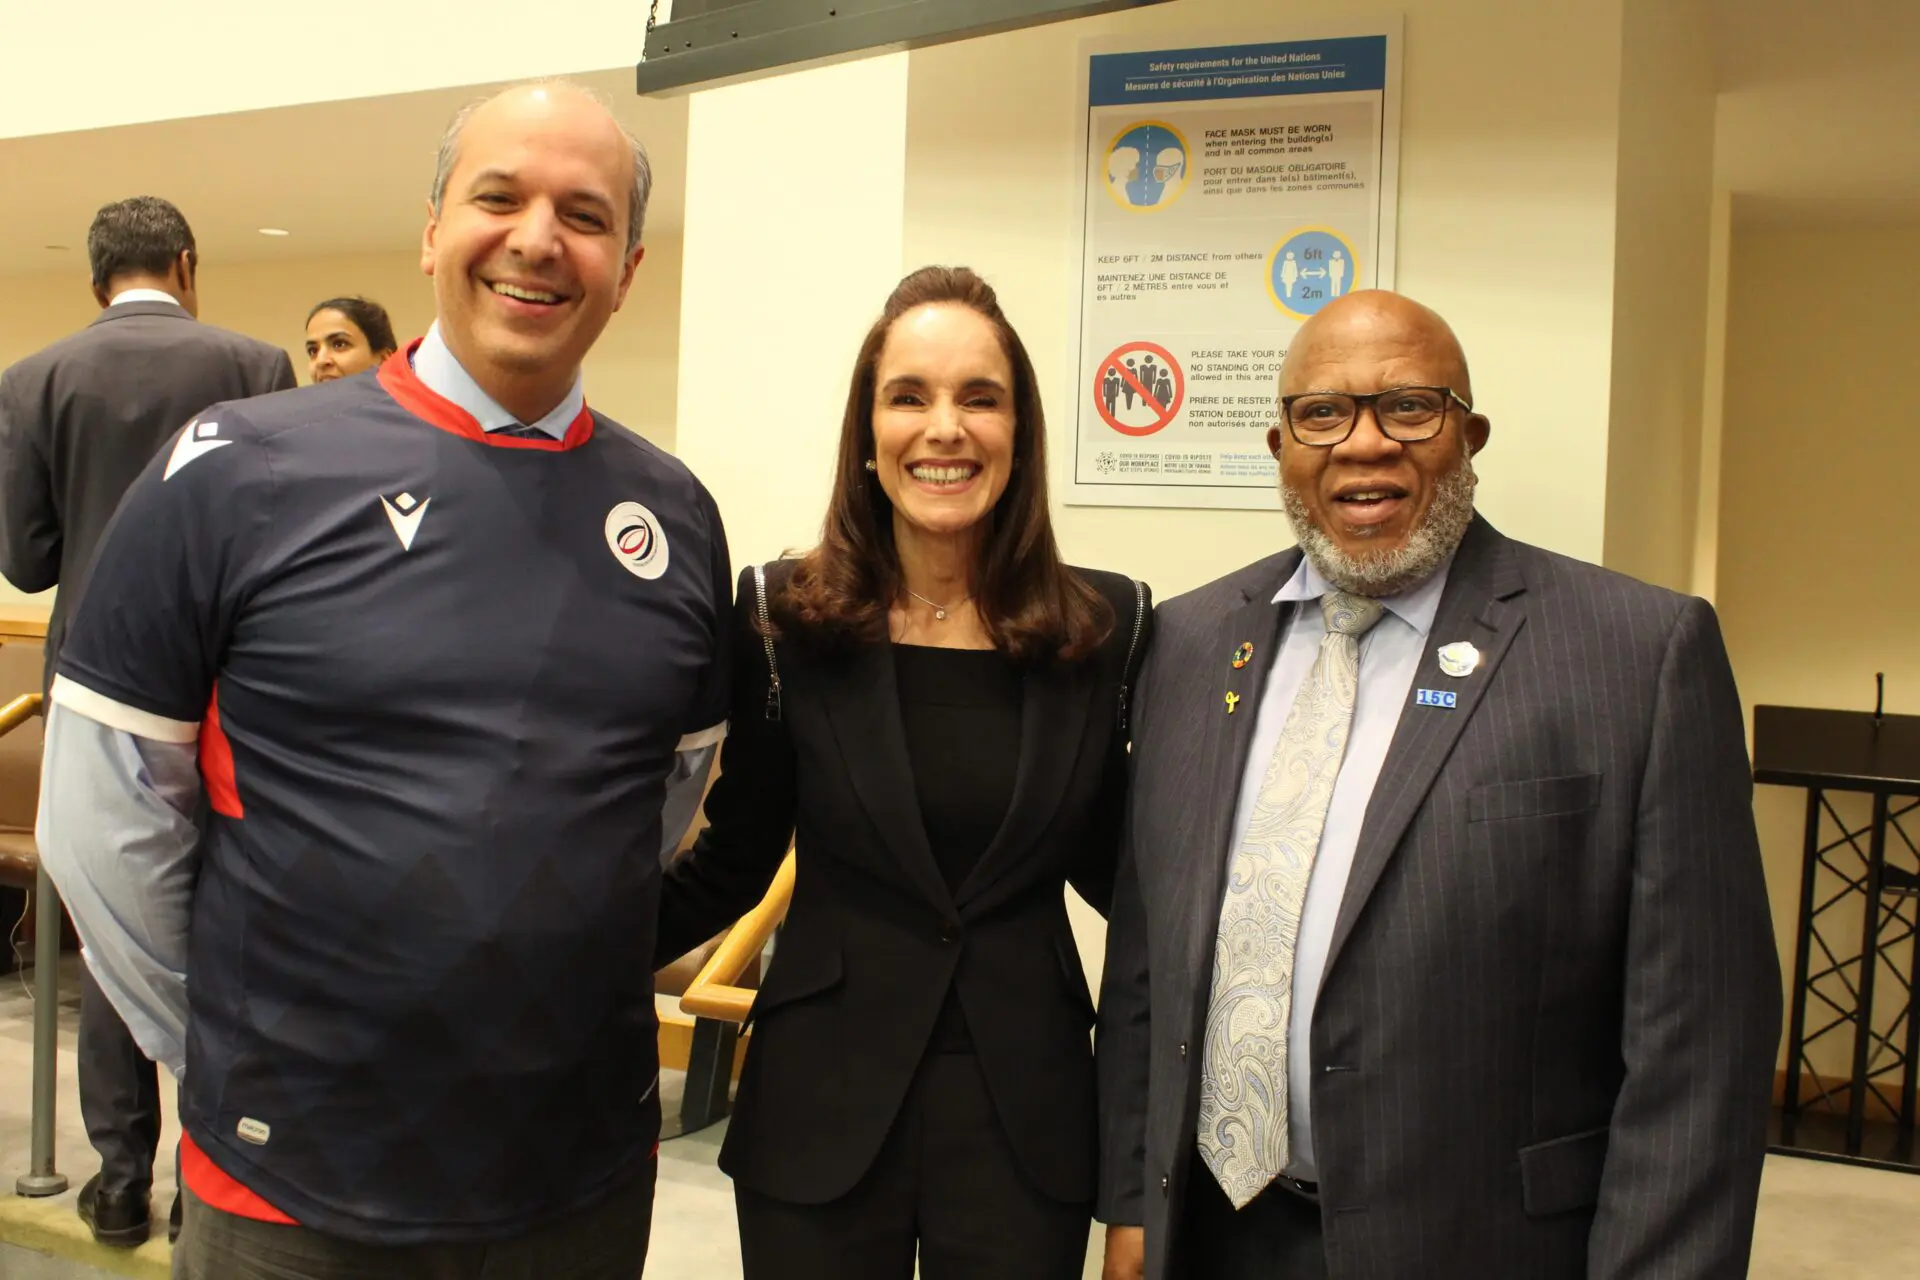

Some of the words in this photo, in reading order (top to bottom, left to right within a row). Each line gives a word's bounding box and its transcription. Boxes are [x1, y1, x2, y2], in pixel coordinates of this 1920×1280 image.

[1149, 62, 1175, 72] Safety
[1176, 59, 1229, 71] requirements
[1231, 57, 1245, 67] for
[1245, 56, 1258, 65] the
[1260, 54, 1287, 65] United
[1289, 52, 1321, 62] Nations
[1125, 82, 1159, 92] Mesures
[1160, 80, 1170, 89] de
[1172, 78, 1205, 89] sécurité
[1206, 76, 1211, 86] à
[1271, 72, 1286, 82] des
[1288, 71, 1320, 81] Nations
[1321, 69, 1346, 79] Unies
[1205, 129, 1227, 139] FACE
[1230, 128, 1256, 137] MASK
[1259, 127, 1284, 136] MUST
[1288, 125, 1300, 135] BE
[1303, 124, 1332, 133] WORN
[1205, 139, 1228, 148] when
[1230, 136, 1266, 147] entering
[1270, 136, 1284, 145] the
[1287, 133, 1334, 144] building(s)
[1204, 148, 1221, 157] and
[1223, 148, 1231, 156] in
[1234, 147, 1245, 156] all
[1247, 146, 1285, 156] common
[1288, 145, 1313, 153] areas
[1203, 167, 1227, 176] PORT
[1230, 167, 1244, 175] DU
[1246, 164, 1285, 174] MASQUE
[1287, 162, 1347, 172] OBLIGATOIRE
[1203, 178, 1223, 186] pour
[1226, 176, 1252, 185] entrer
[1255, 174, 1277, 184] dans
[1203, 186, 1224, 195] ainsi
[1226, 186, 1243, 196] que
[1245, 184, 1267, 194] dans
[1287, 184, 1313, 192] zones
[1316, 182, 1365, 191] communes
[1097, 256, 1120, 264] KEEP
[1123, 255, 1140, 263] 6FT
[1150, 254, 1163, 263] 2M
[1166, 253, 1208, 262] DISTANCE
[1212, 253, 1232, 261] from
[1235, 252, 1263, 260] others
[1304, 247, 1323, 260] 6ft
[1097, 274, 1145, 282] MAINTENEZ
[1148, 273, 1166, 281] UNE
[1169, 272, 1211, 281] DISTANCE
[1215, 272, 1227, 280] DE
[1097, 284, 1113, 292] 6FT
[1124, 283, 1129, 291] 2
[1171, 282, 1193, 290] entre
[1220, 281, 1229, 289] et
[1302, 286, 1323, 299] 2m
[1110, 293, 1137, 301] autres
[1191, 350, 1223, 358] PLEASE
[1227, 350, 1248, 358] TAKE
[1251, 350, 1275, 358] YOUR
[1190, 364, 1203, 372] NO
[1207, 364, 1249, 372] STANDING
[1252, 364, 1265, 372] OR
[1268, 364, 1281, 372] CO
[1190, 373, 1222, 381] allowed
[1225, 373, 1233, 381] in
[1236, 373, 1251, 381] this
[1222, 396, 1234, 405] DE
[1237, 396, 1271, 405] RESTER
[1189, 410, 1223, 418] STATION
[1226, 410, 1261, 418] DEBOUT
[1265, 410, 1278, 418] OU
